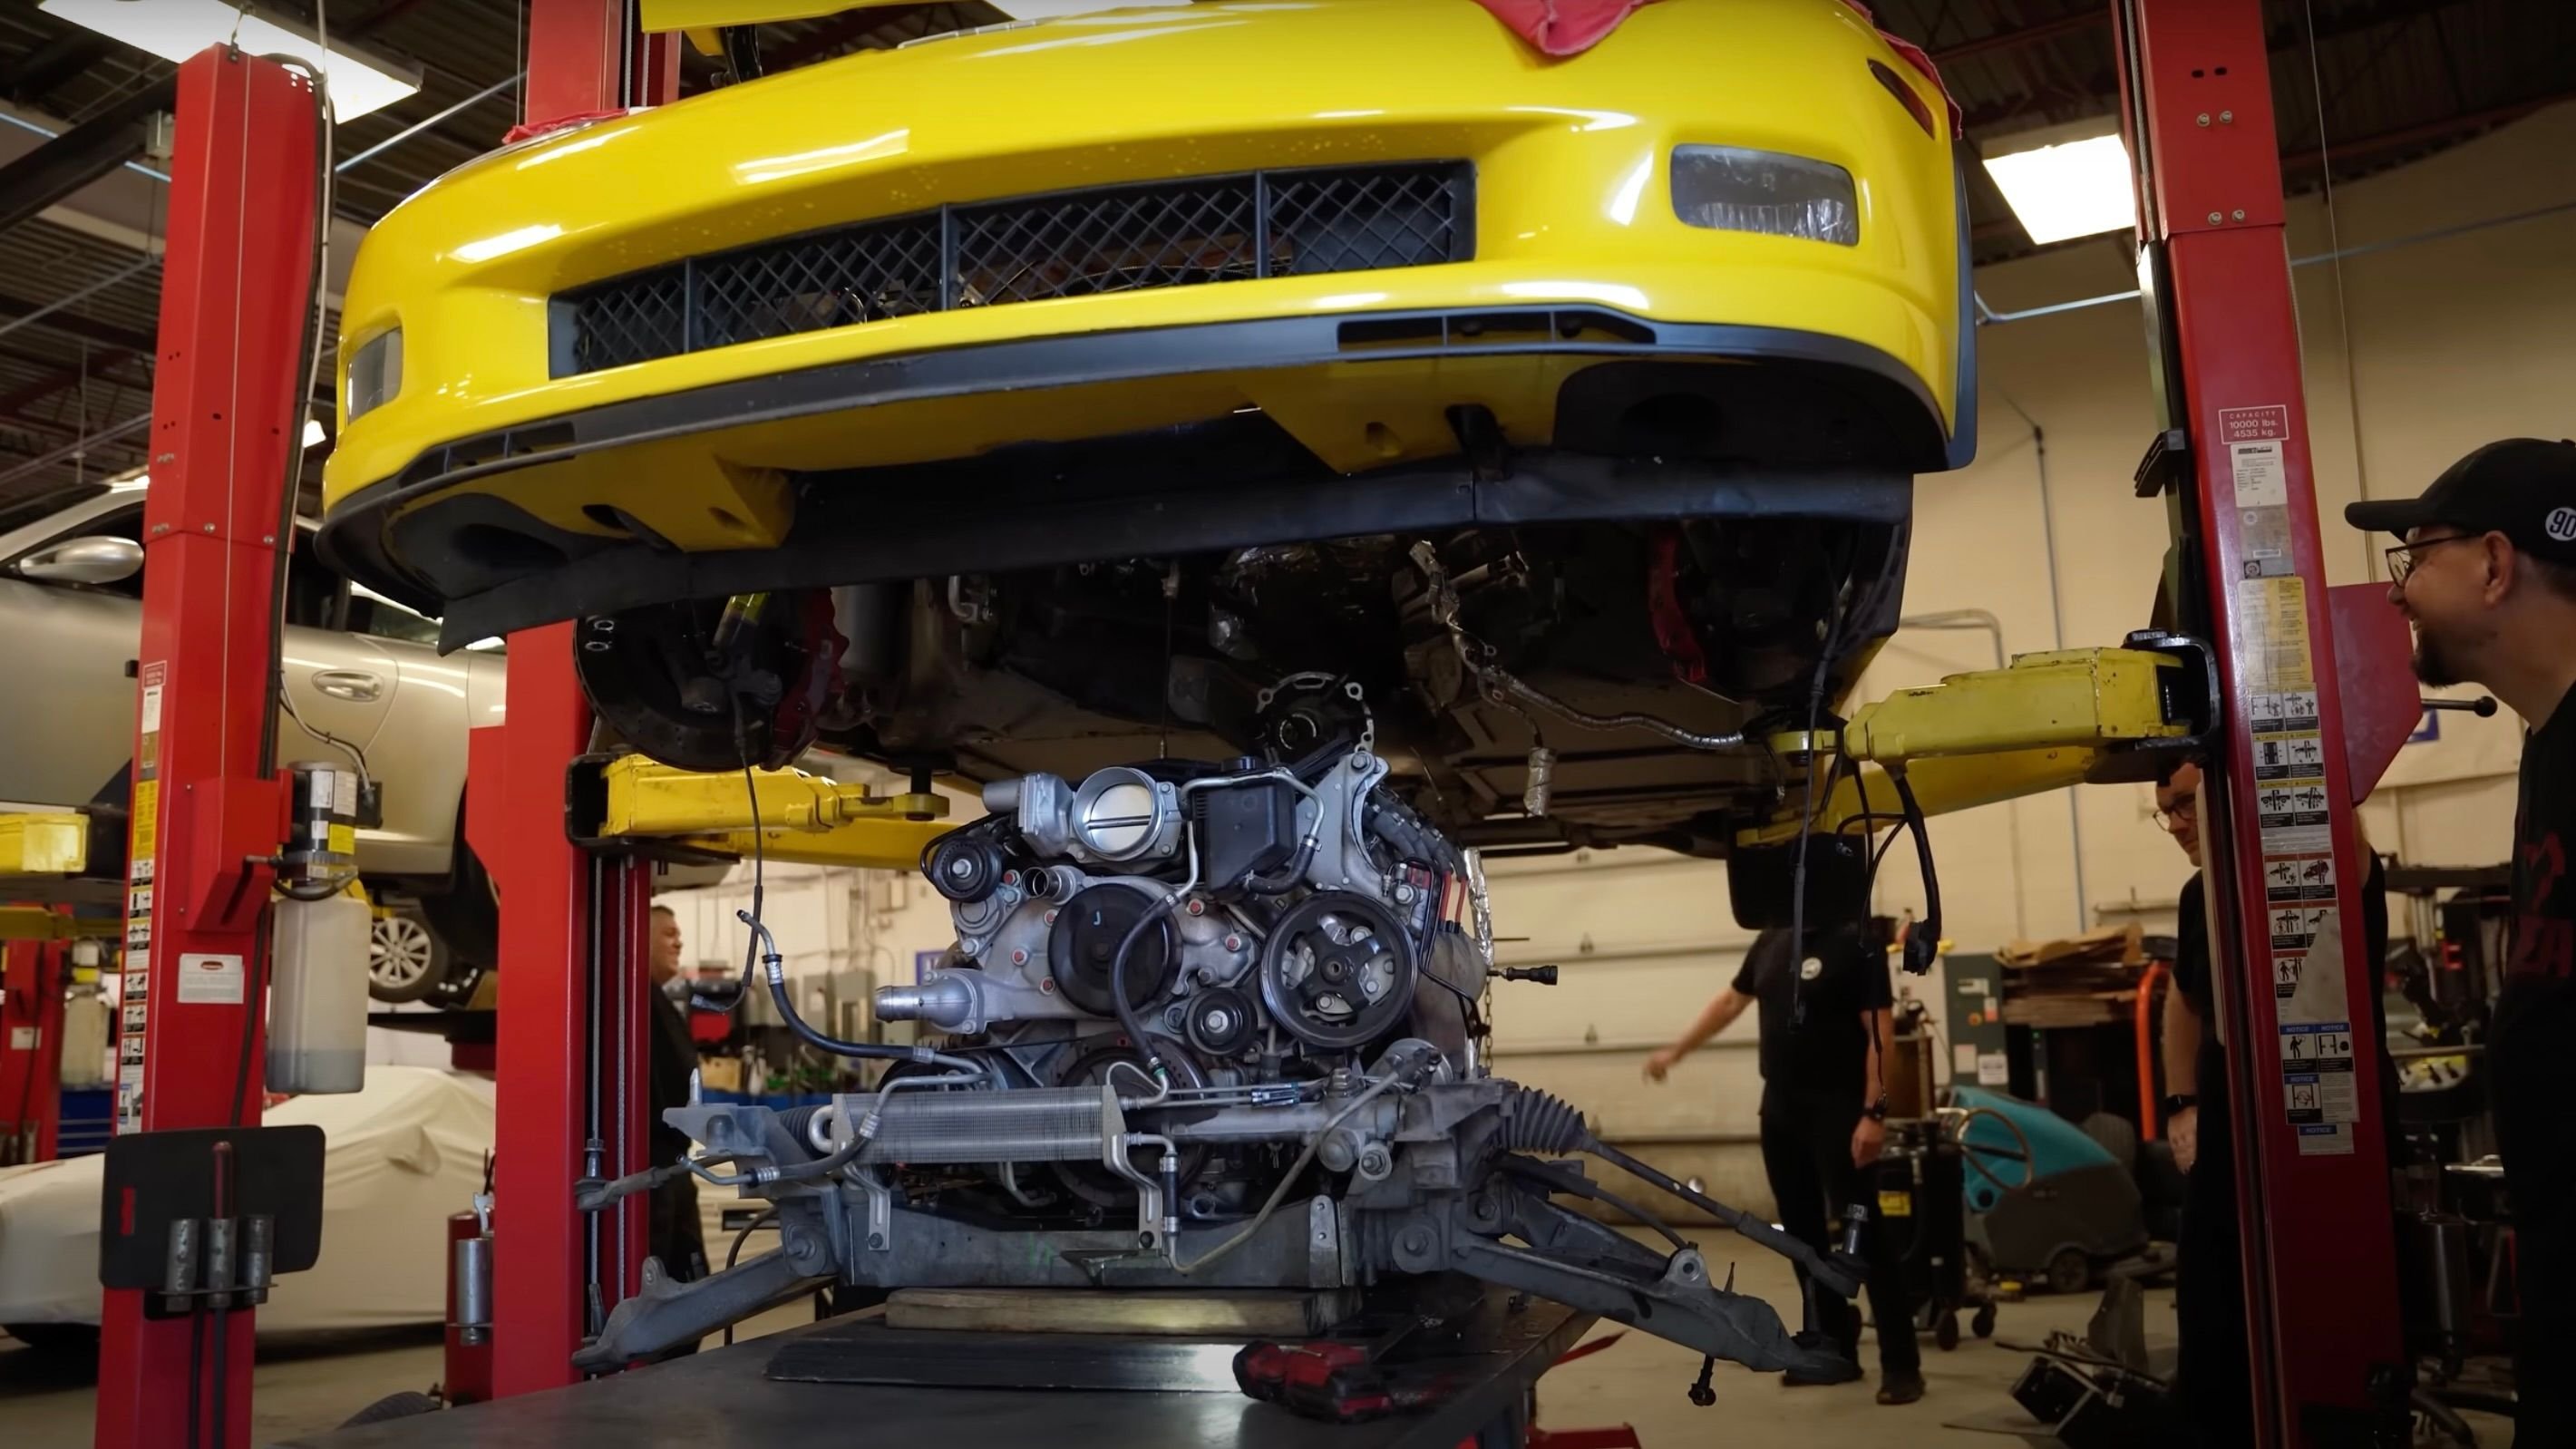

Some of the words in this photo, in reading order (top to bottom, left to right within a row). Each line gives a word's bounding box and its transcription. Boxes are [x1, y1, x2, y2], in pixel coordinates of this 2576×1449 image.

[2229, 411, 2276, 420] CAPACITY
[2229, 420, 2259, 429] 10000
[2261, 418, 2278, 427] lbs.
[2233, 429, 2258, 438] 4535
[2261, 428, 2277, 437] kg.
